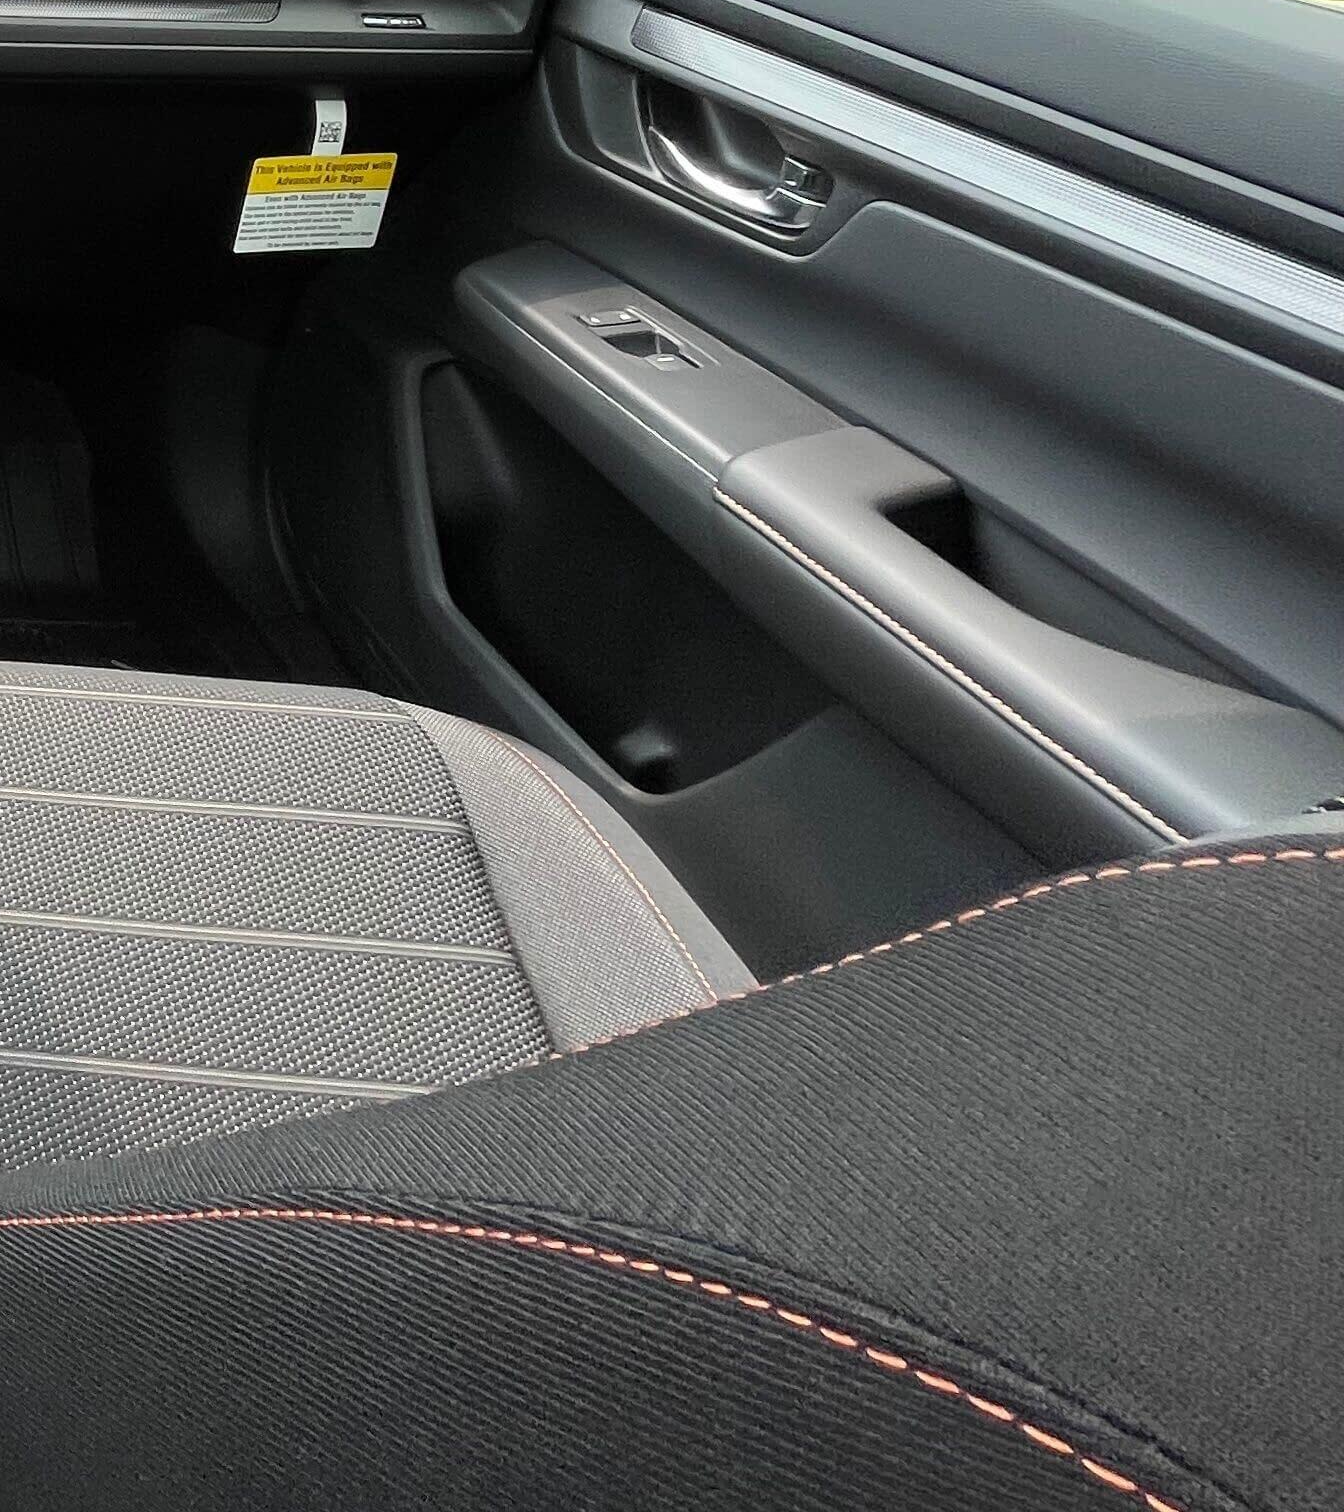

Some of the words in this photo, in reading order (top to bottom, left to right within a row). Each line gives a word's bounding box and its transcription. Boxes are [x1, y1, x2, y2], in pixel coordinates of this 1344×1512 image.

[325, 161, 369, 173] Equipped
[372, 160, 393, 170] with
[276, 175, 322, 186] Advanced
[323, 174, 338, 183] Air
[340, 174, 365, 185] Bags
